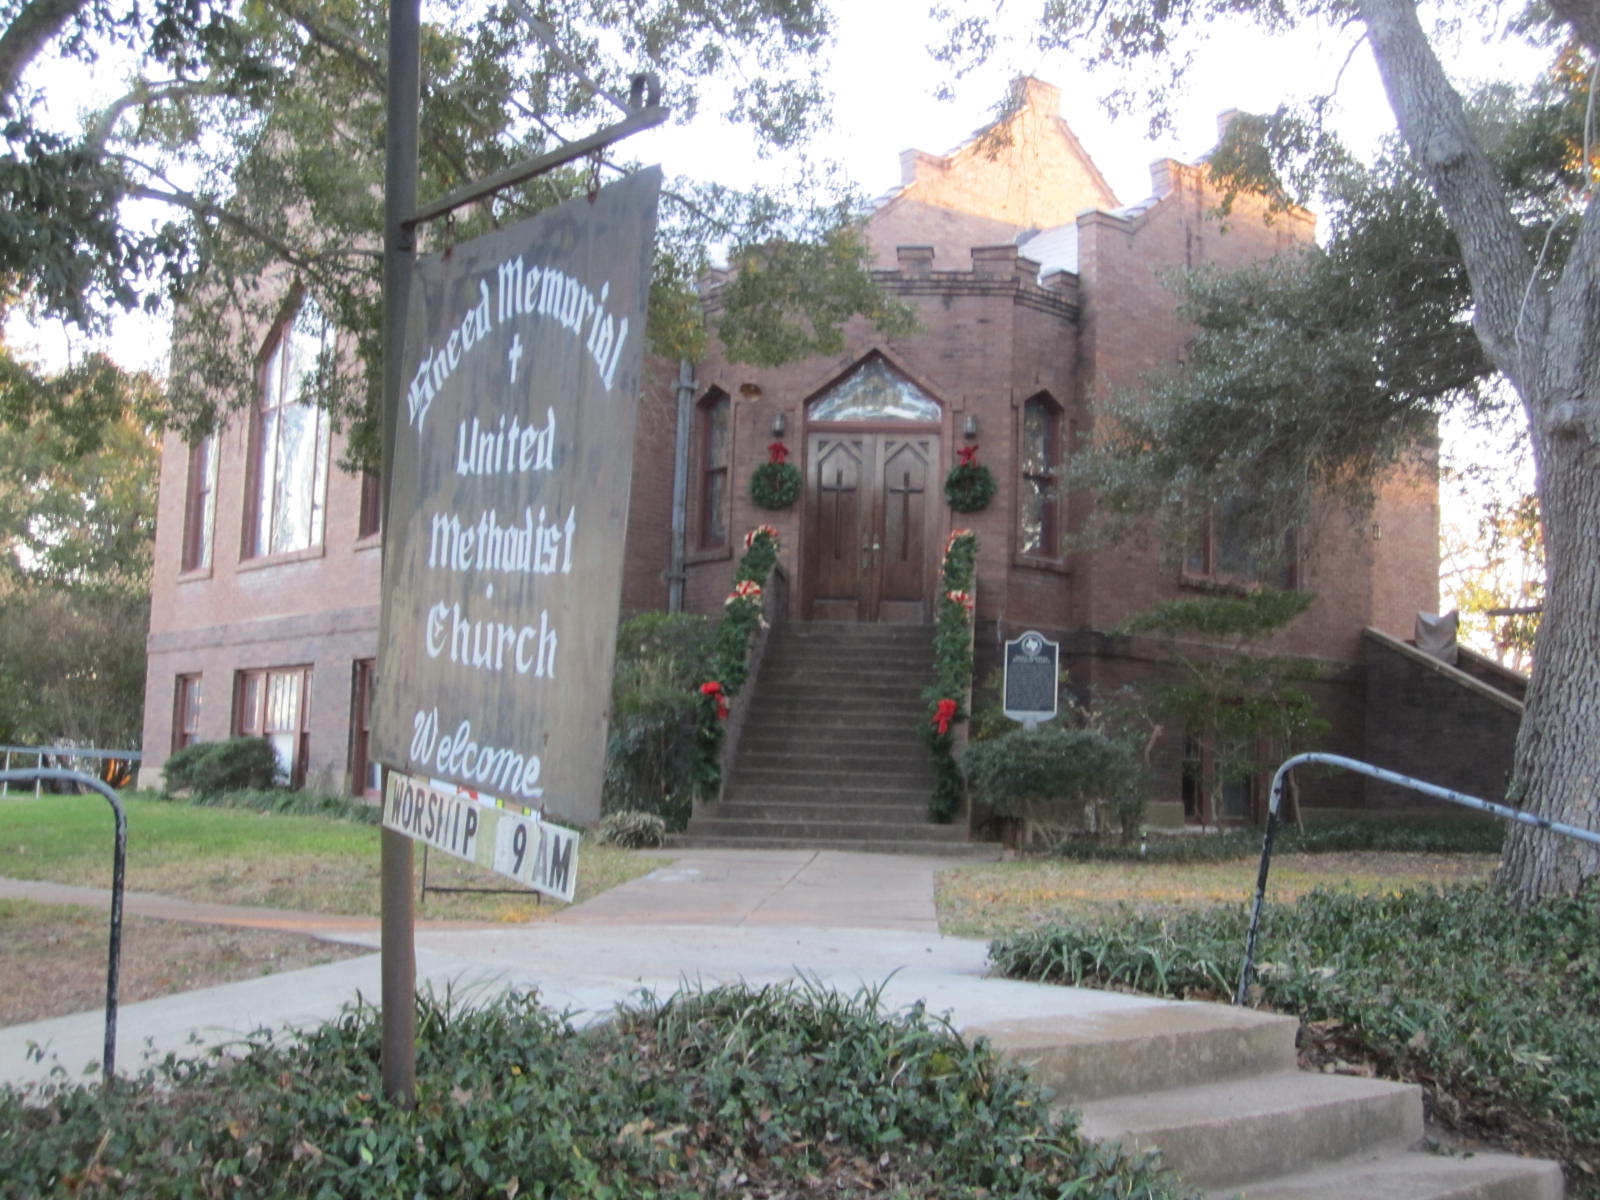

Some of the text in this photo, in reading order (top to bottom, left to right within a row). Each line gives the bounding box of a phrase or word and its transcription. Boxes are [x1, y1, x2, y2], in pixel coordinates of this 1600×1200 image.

[407, 255, 628, 434] Sneed Memorial
[456, 405, 556, 476] United
[429, 505, 576, 574] Methodist
[426, 600, 558, 678] Church
[410, 706, 544, 798] Welcome
[391, 777, 573, 893] WORSHIP 9 AM
